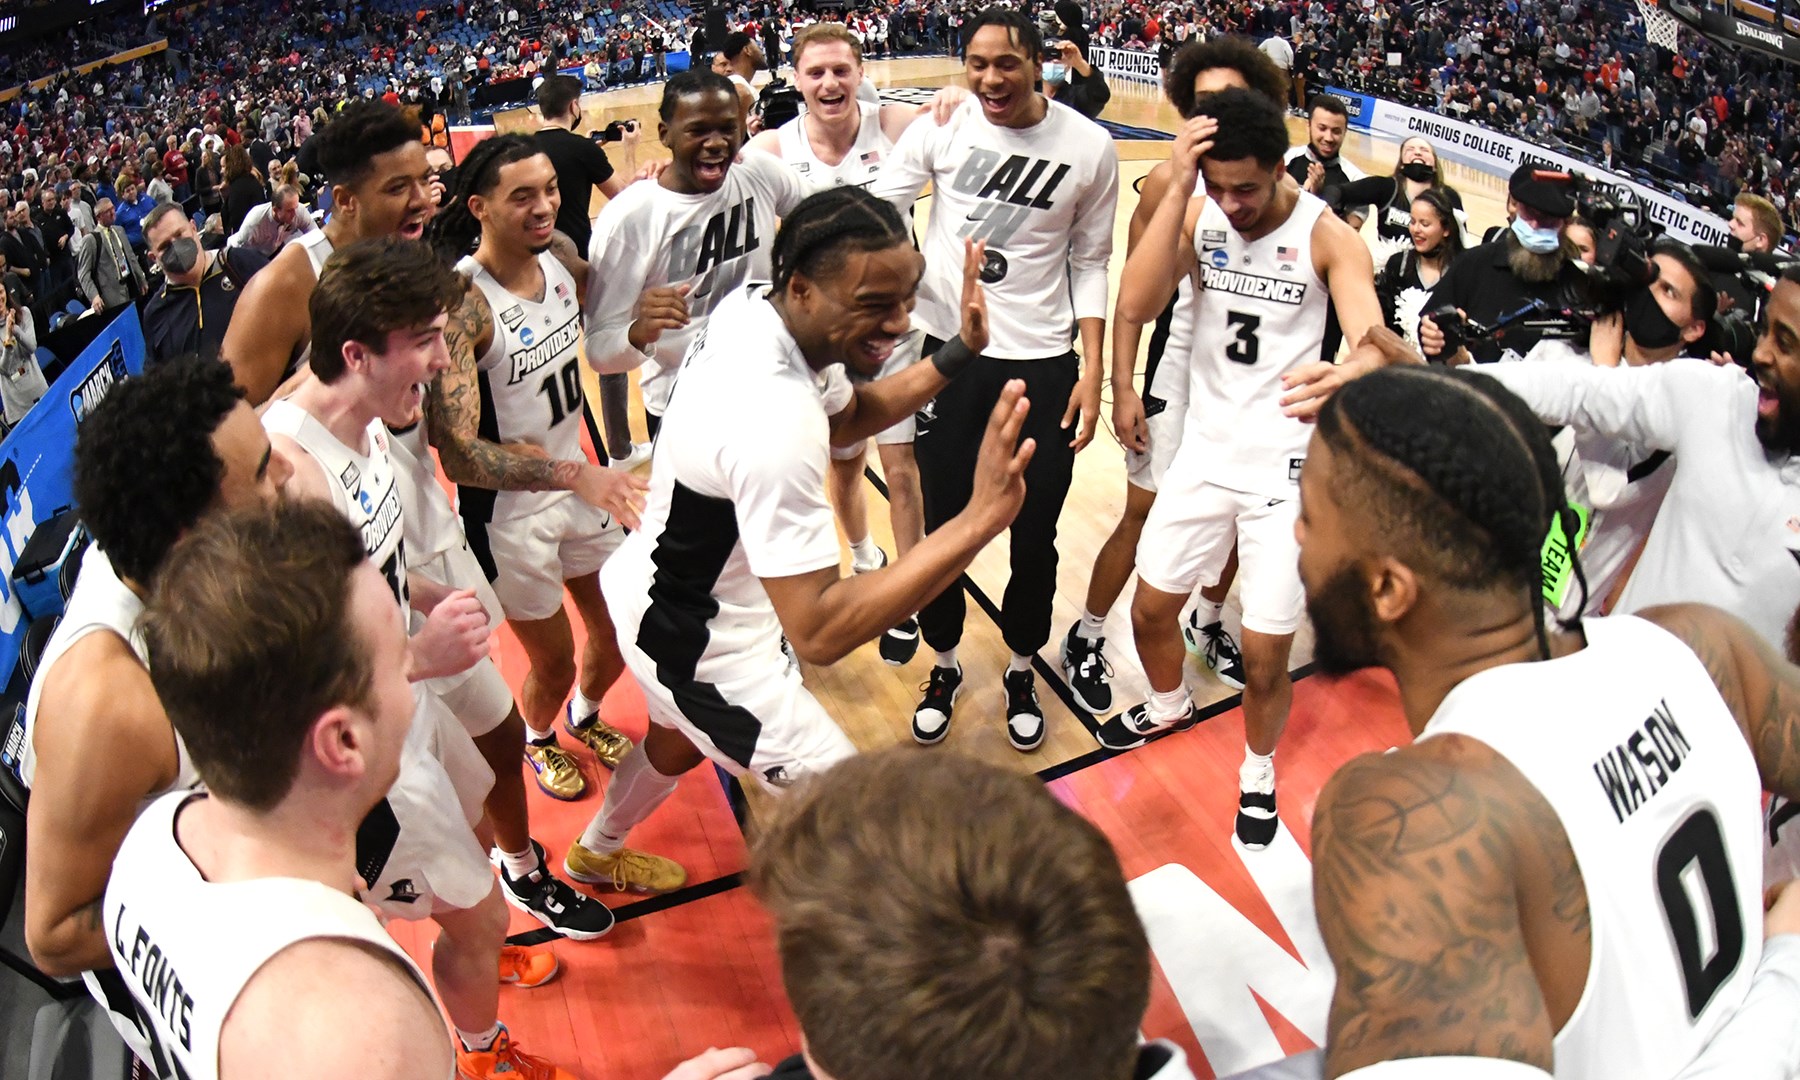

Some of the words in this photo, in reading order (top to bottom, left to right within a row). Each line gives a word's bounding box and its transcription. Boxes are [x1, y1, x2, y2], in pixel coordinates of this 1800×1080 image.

[1109, 51, 1160, 76] ROUNDS
[1736, 21, 1783, 50] SPALDING
[1408, 116, 1461, 144] CANISIUS
[1463, 133, 1515, 164] COLLEGE,
[952, 147, 1072, 211] BALL
[667, 196, 760, 284] BALL
[956, 201, 1032, 250] IN
[1199, 260, 1307, 306] PROVIDENCE
[507, 312, 581, 386] PROVIDENC
[1226, 310, 1262, 366] 3
[536, 356, 584, 431] 10
[1652, 801, 1746, 1027] 0
